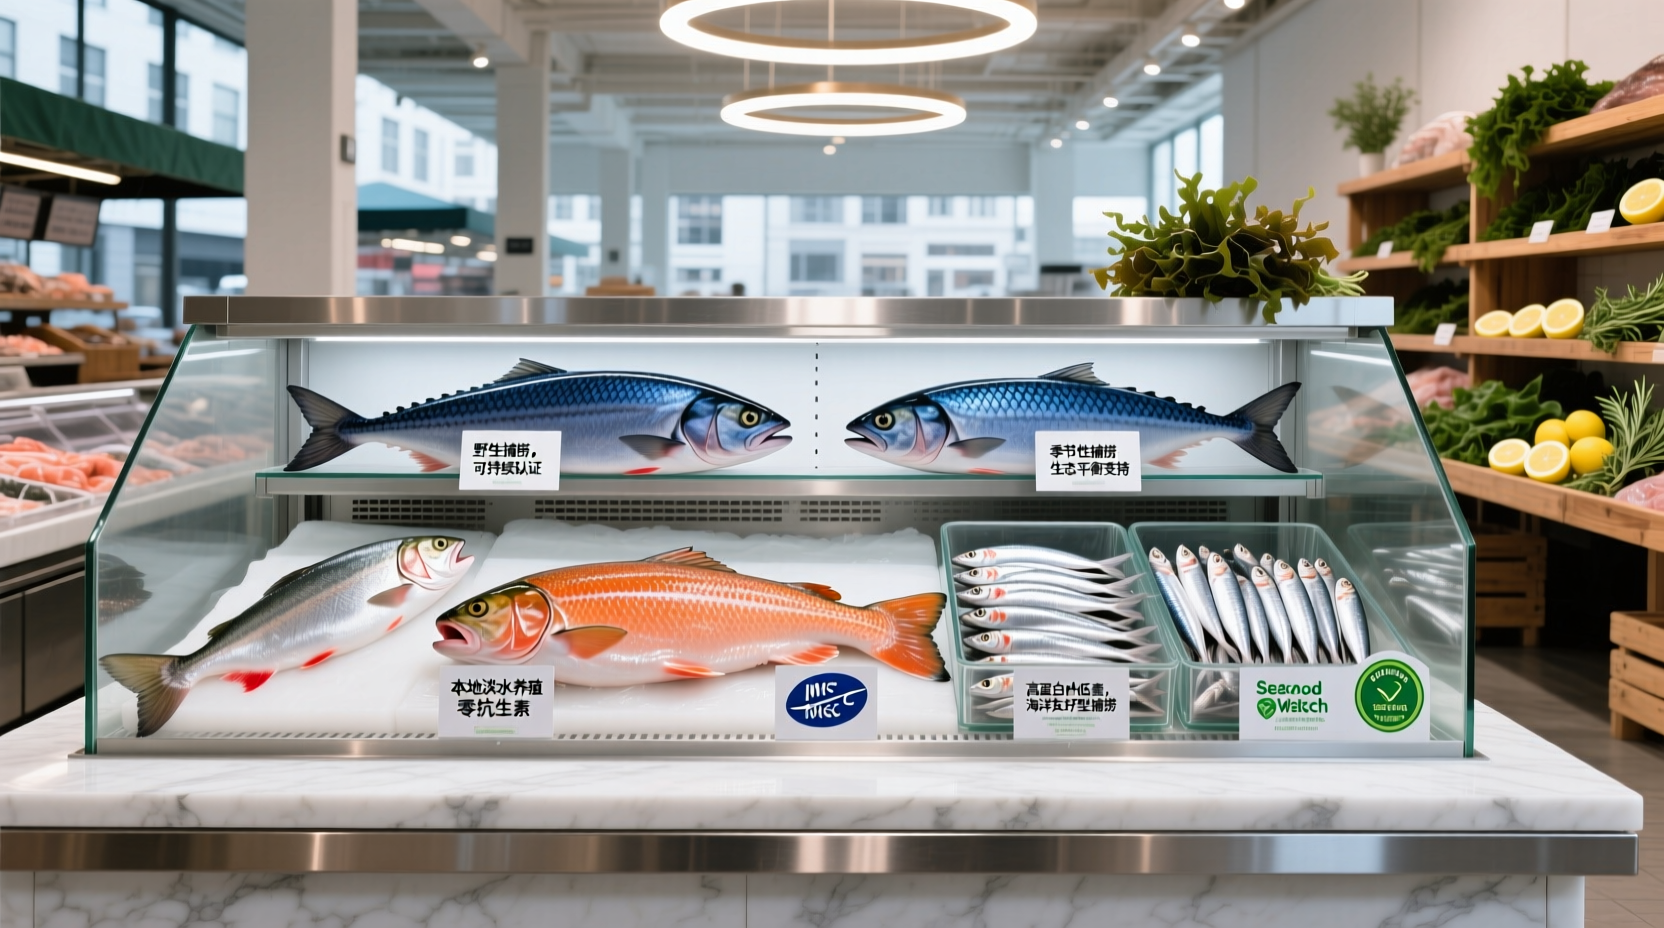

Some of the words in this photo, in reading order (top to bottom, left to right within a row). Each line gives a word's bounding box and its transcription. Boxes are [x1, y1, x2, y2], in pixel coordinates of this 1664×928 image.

[473, 461, 542, 475] 可持续认证
